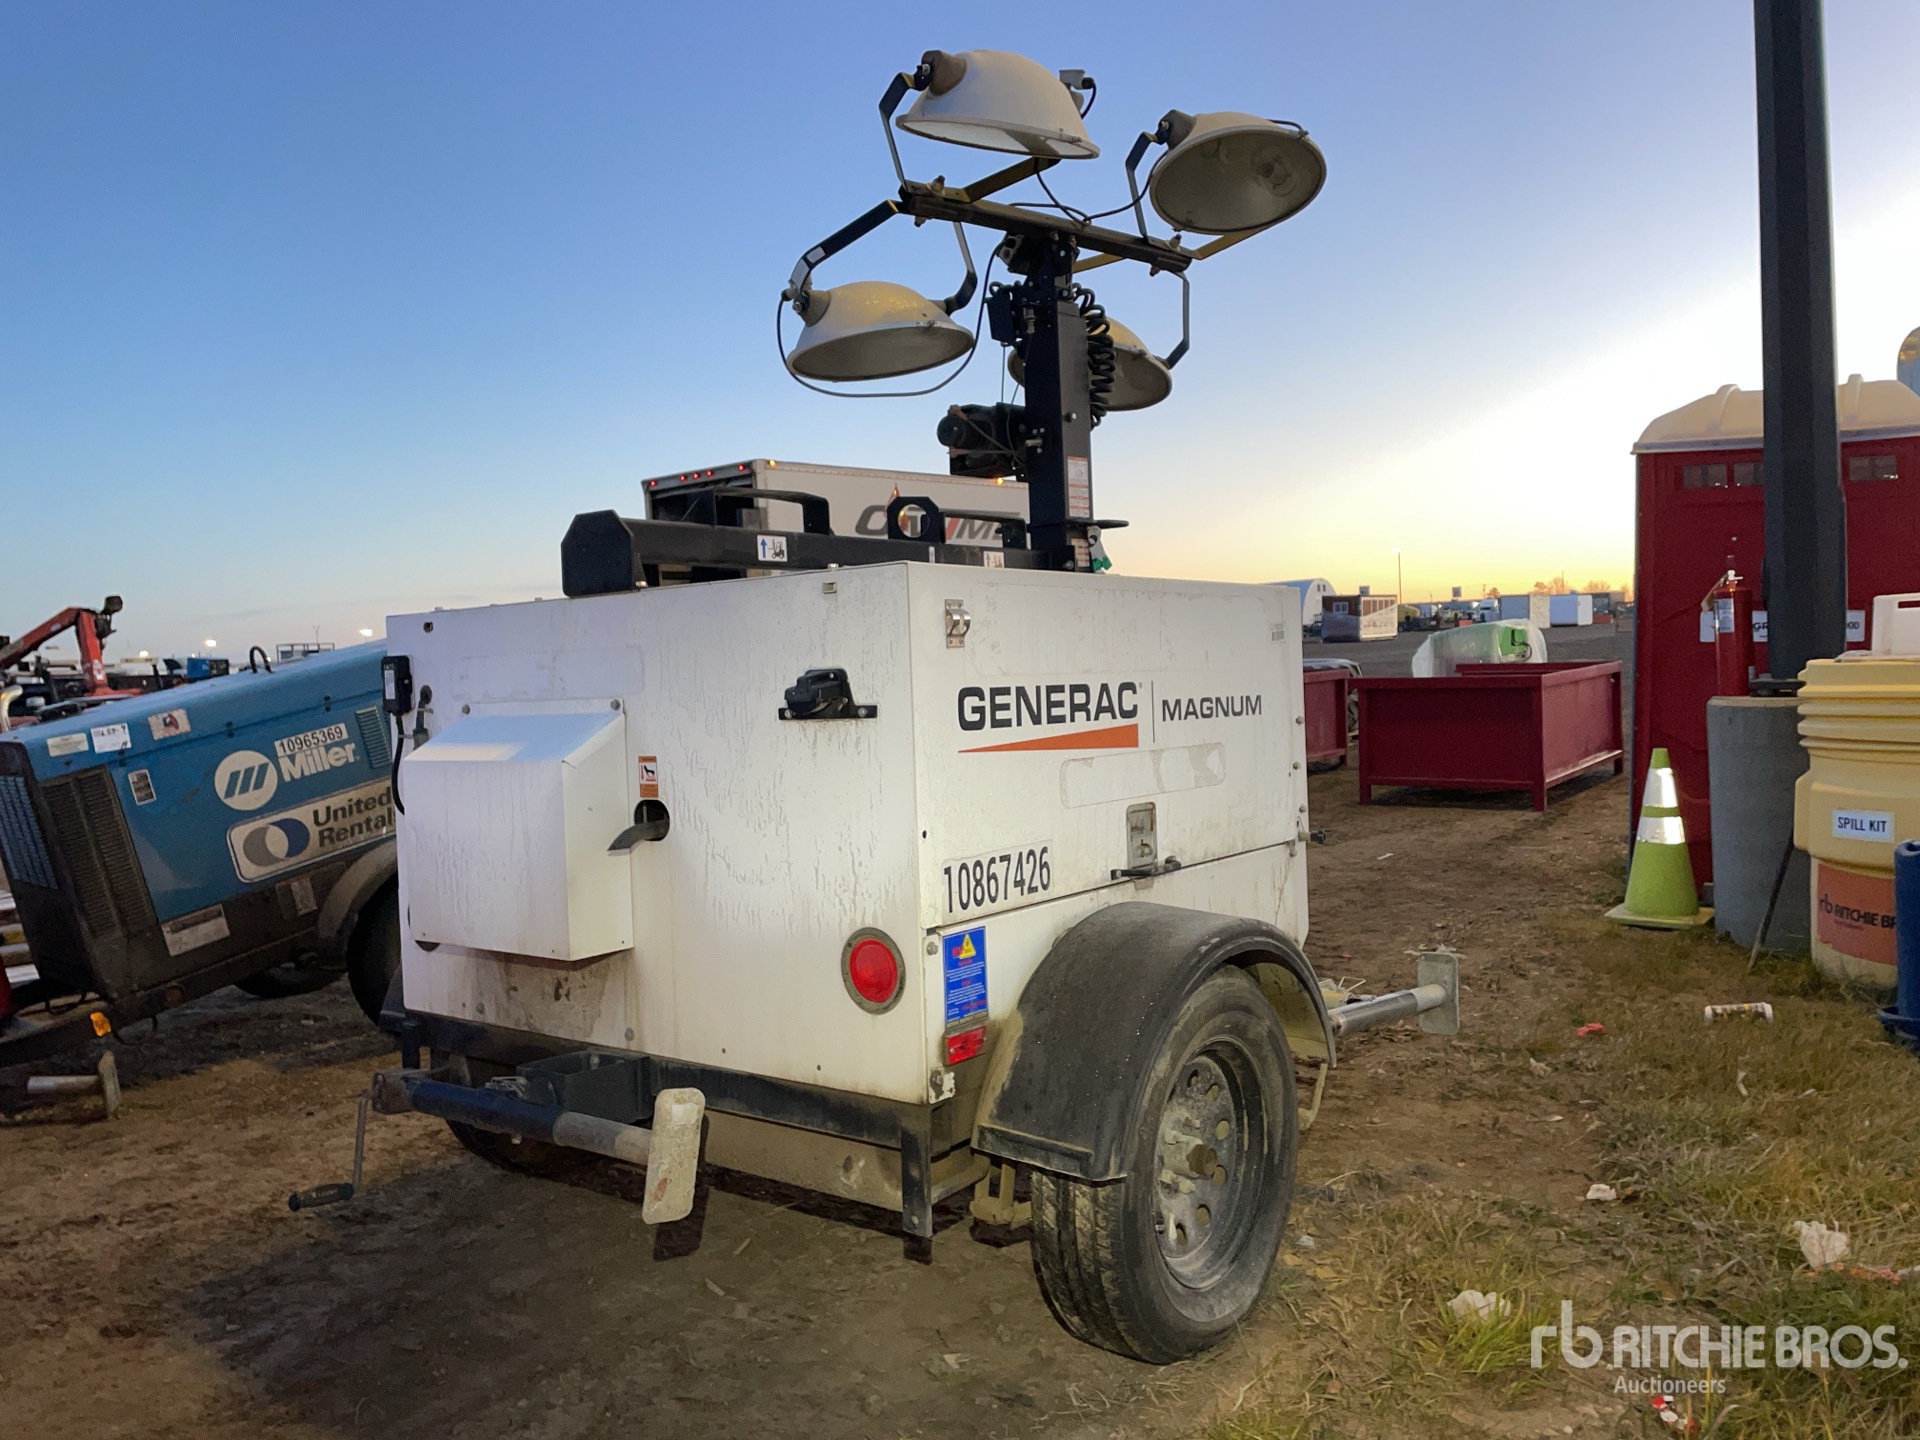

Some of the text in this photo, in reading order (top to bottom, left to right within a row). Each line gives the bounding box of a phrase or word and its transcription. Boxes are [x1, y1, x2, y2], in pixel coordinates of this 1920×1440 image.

[957, 681, 1263, 731] GENERAC MAGNUM
[278, 725, 344, 754] 10965369
[278, 742, 357, 782] Miller
[312, 787, 392, 828] United
[318, 806, 397, 848] Rental
[1837, 816, 1888, 833] SPILL KIT
[943, 845, 1051, 914] 10867426
[1834, 904, 1880, 927] RITCHIE
